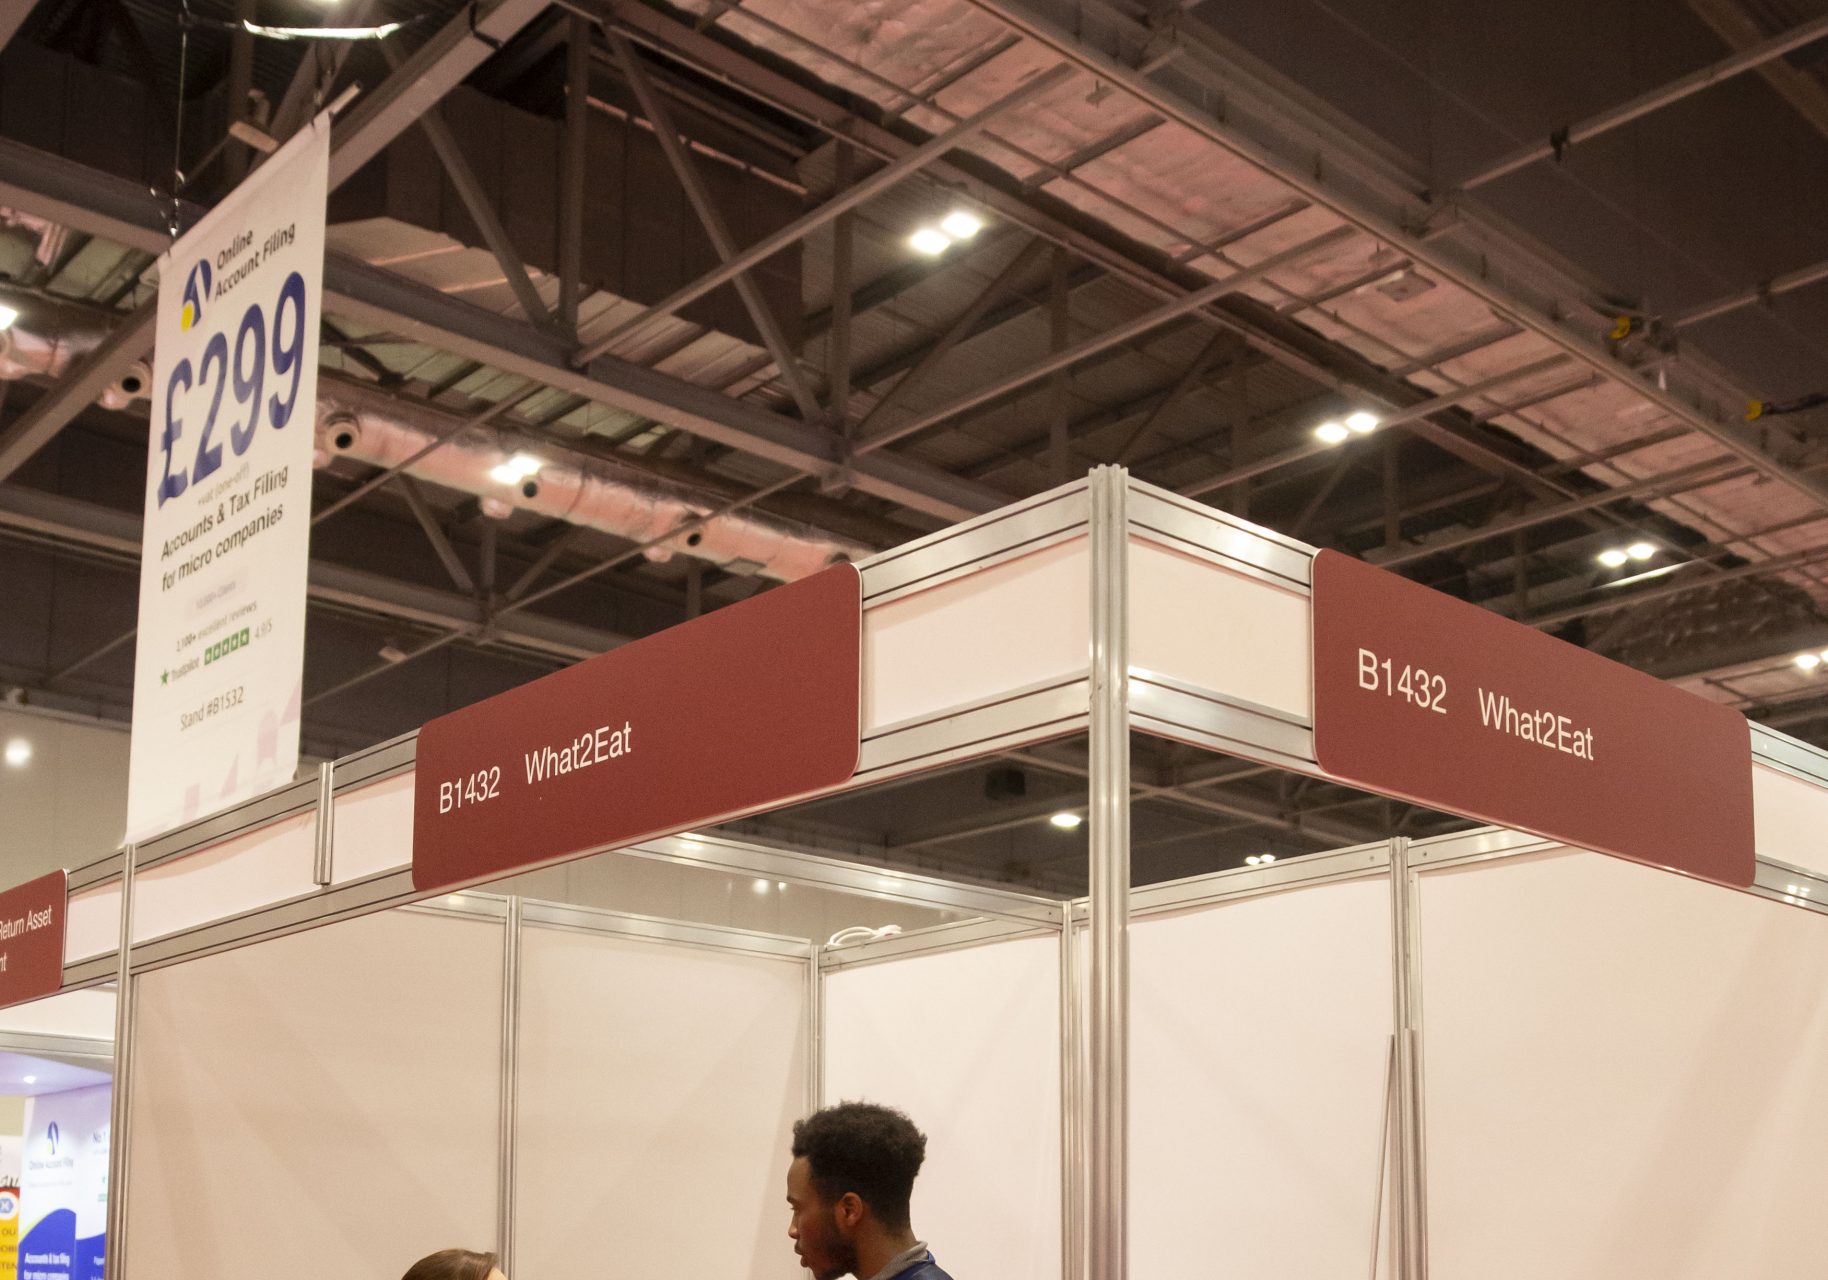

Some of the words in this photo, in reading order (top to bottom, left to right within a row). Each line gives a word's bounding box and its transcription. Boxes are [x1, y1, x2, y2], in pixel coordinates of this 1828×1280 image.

[215, 250, 260, 302] Account
[263, 222, 295, 262] Filing
[217, 230, 253, 270] Online
[158, 271, 306, 510] £299
[161, 515, 213, 561] Accounts
[216, 503, 225, 524] &
[230, 490, 250, 516] Tax
[254, 465, 288, 500] Filing
[162, 570, 176, 592] for
[178, 548, 212, 580] micro
[215, 503, 283, 558] companies
[180, 703, 204, 732] Stand
[206, 685, 245, 717] #B1532
[1358, 647, 1447, 714] B1432
[1478, 687, 1594, 761] What2Eat
[439, 766, 500, 814] B1432
[525, 721, 632, 785] What2Eat
[0, 916, 25, 941] Return
[26, 904, 53, 933] Asset
